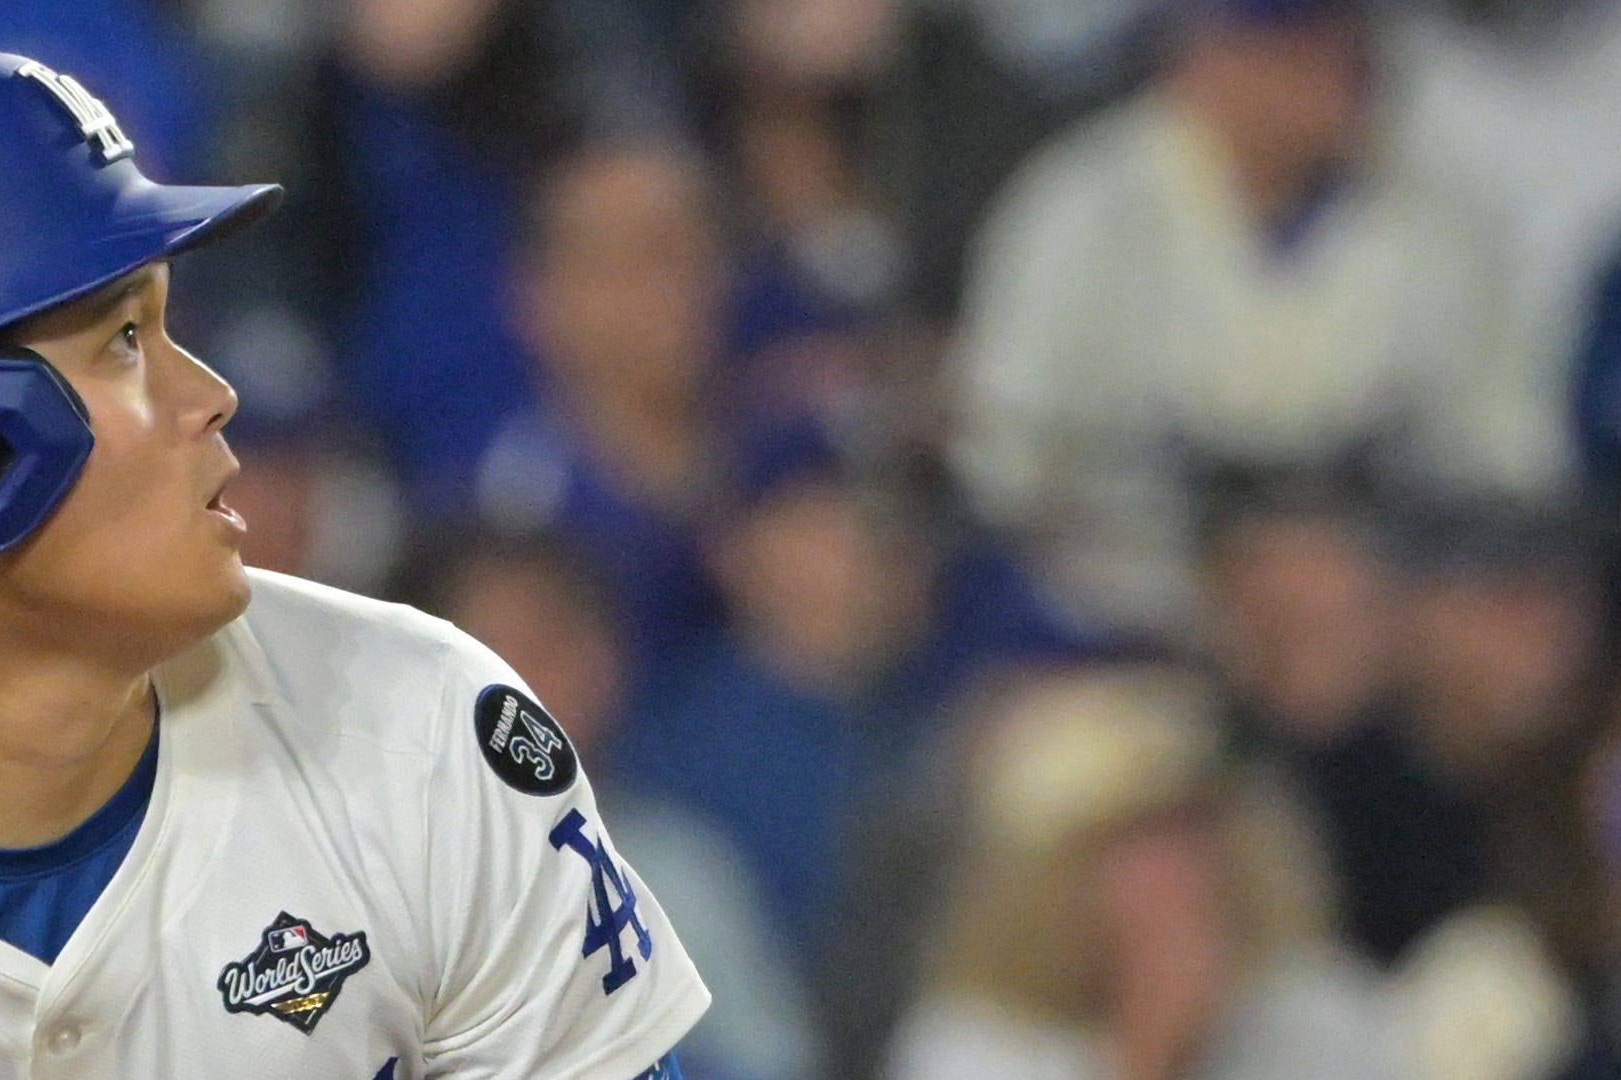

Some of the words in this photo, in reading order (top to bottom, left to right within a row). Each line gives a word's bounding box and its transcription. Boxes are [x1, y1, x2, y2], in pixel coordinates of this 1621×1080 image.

[488, 694, 519, 754] FERNANDO
[508, 709, 563, 780] 34
[548, 807, 653, 996] LA
[224, 951, 304, 1005] World
[293, 937, 364, 995] Series
